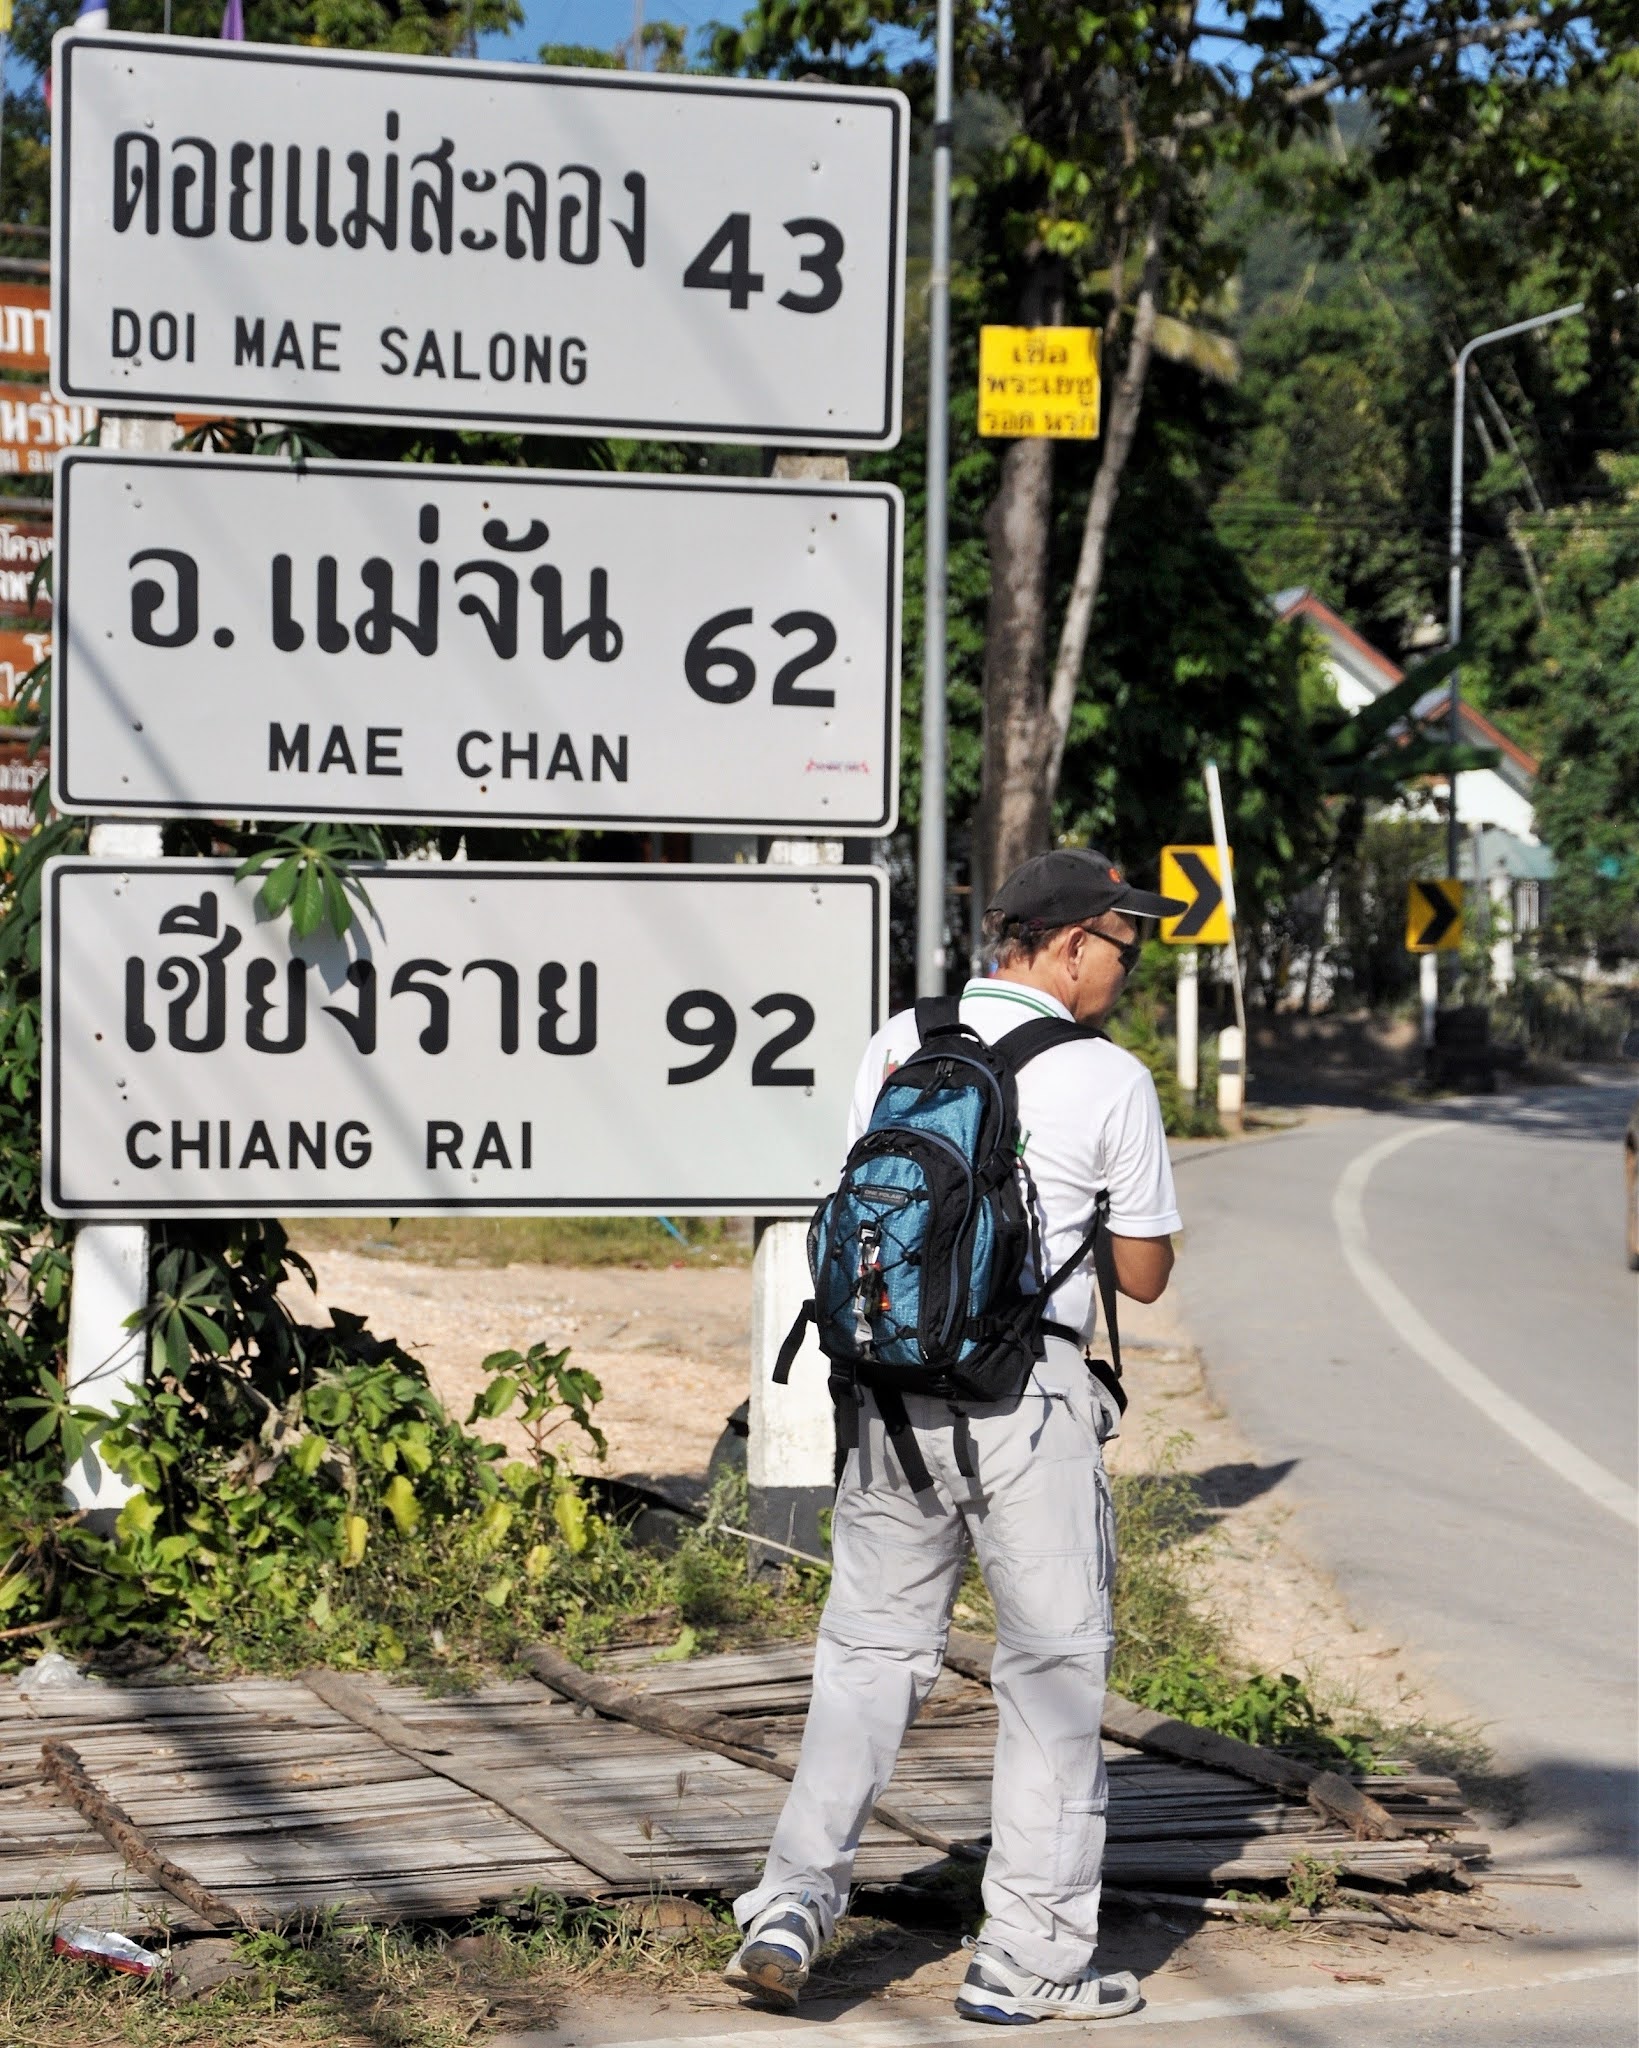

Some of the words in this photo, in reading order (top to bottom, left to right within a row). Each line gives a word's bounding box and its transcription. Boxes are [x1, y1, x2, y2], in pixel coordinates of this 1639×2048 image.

[112, 110, 647, 269] ดอยแม่สะลอง
[682, 212, 845, 314] 43
[112, 307, 196, 363] DOI
[234, 316, 341, 373] MAE
[380, 327, 588, 386] SALONG
[128, 548, 236, 649] อ.
[271, 503, 624, 663] แม่จัน
[684, 607, 838, 709] 62
[268, 722, 404, 777] MAE
[457, 730, 629, 783] CHAN
[125, 891, 599, 1056] เชียงราย
[665, 989, 816, 1088] 92
[125, 1120, 374, 1171] CHIANG
[426, 1120, 533, 1171] RAI
